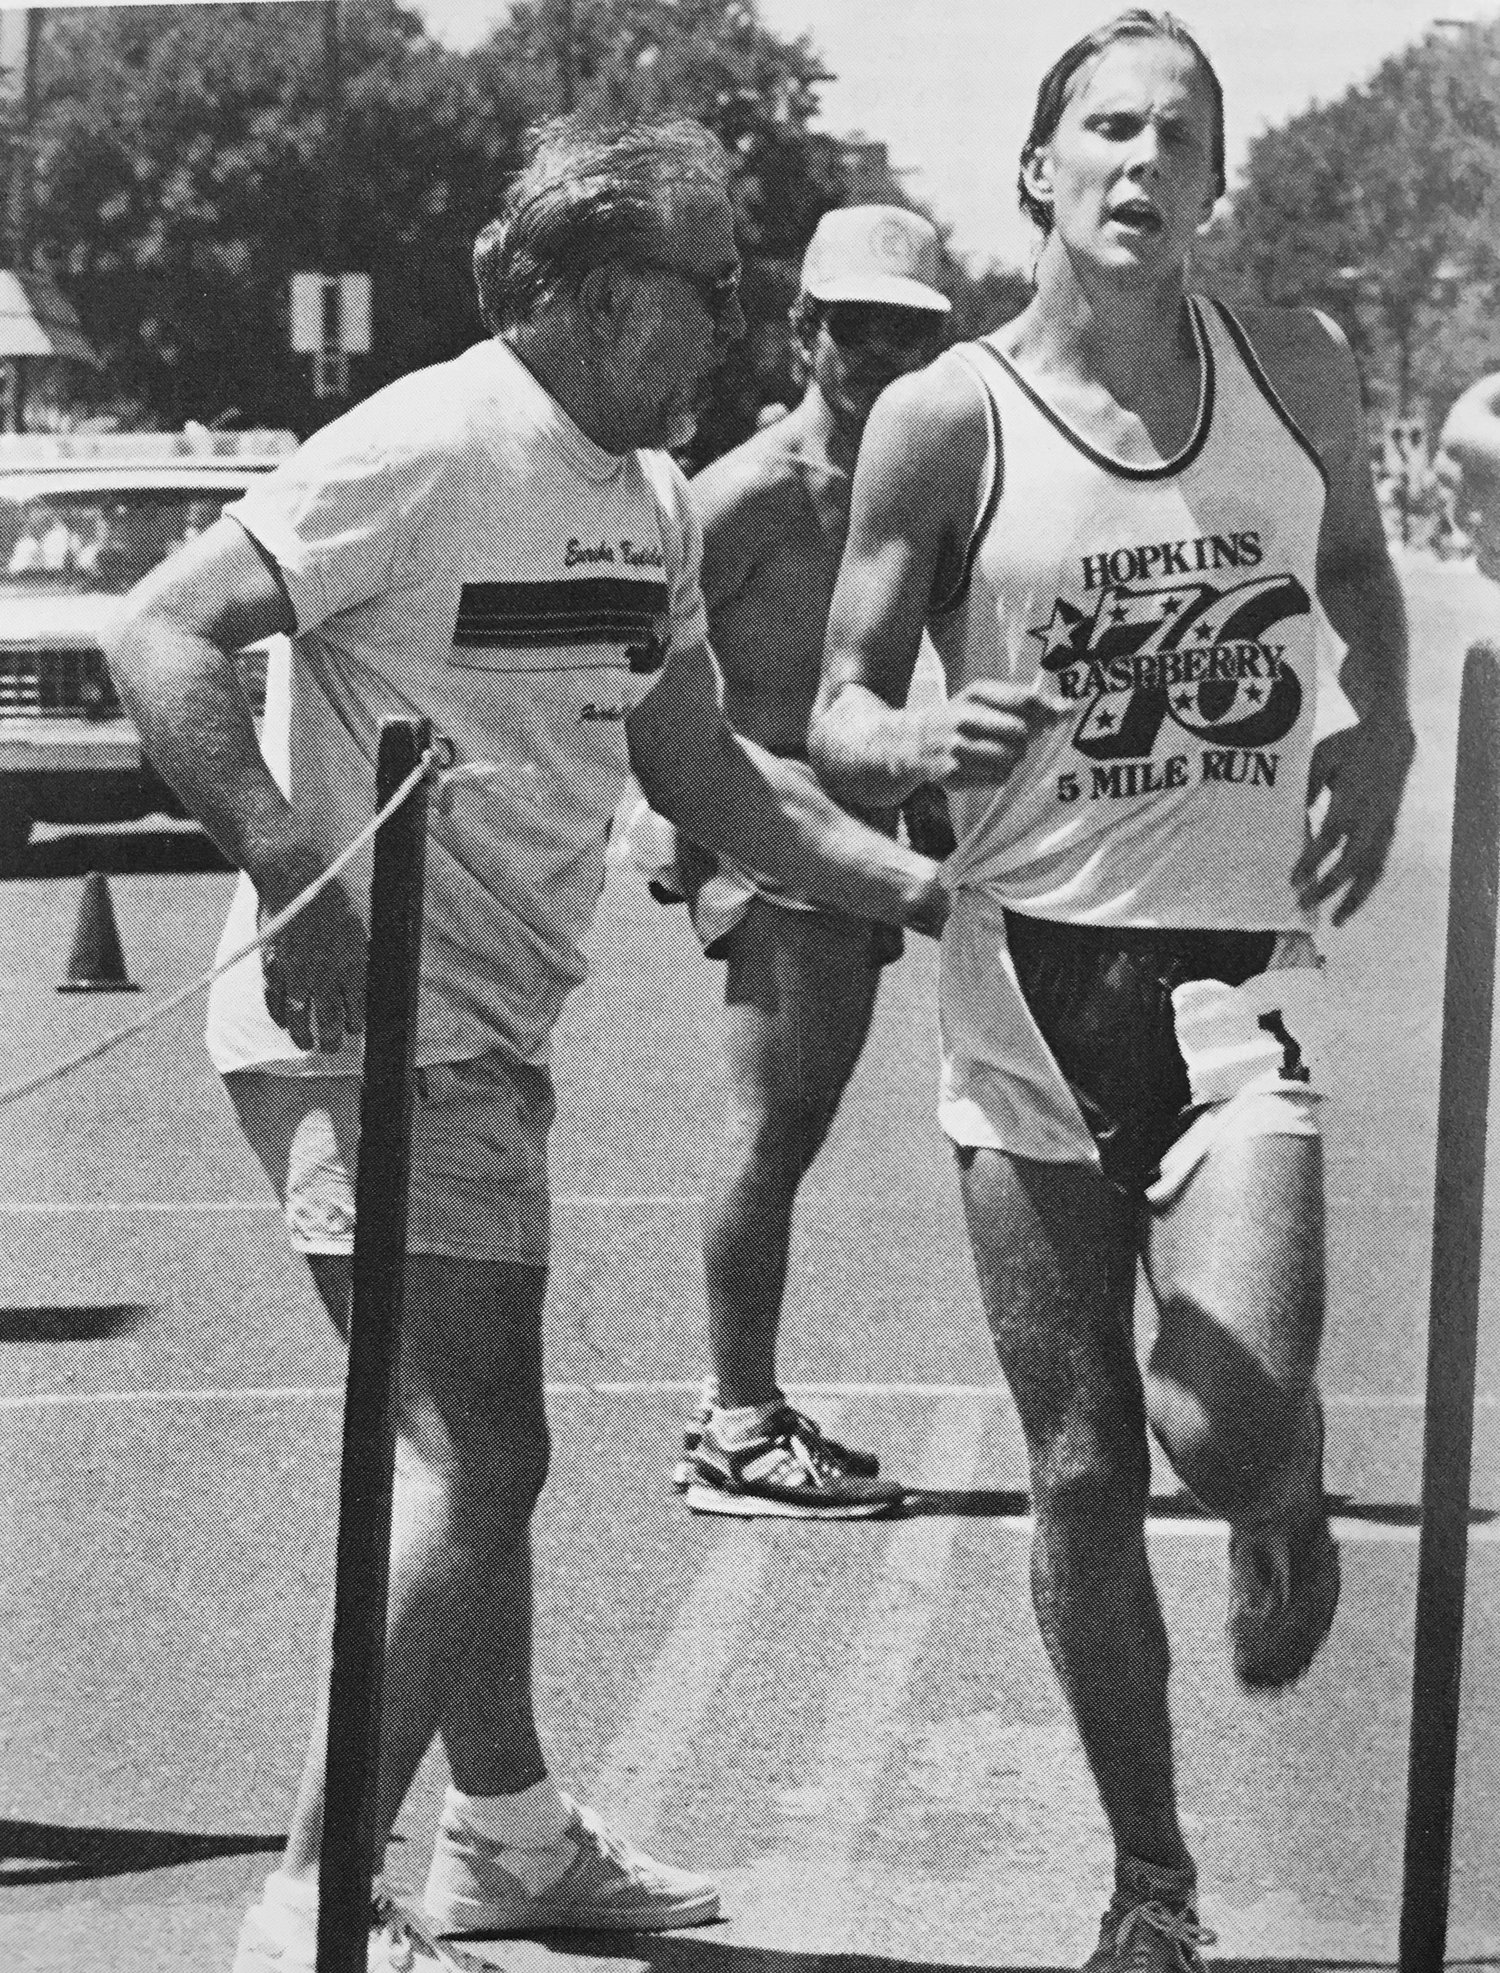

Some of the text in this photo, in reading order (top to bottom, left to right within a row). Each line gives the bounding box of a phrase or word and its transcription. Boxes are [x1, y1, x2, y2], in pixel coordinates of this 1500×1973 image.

[1081, 531, 1264, 592] HOPKINS
[1057, 644, 1286, 701] RASPBERRY
[1072, 572, 1311, 761] 76
[1056, 750, 1280, 802] 5 MILE RUN
[1257, 1009, 1310, 1084] 1
